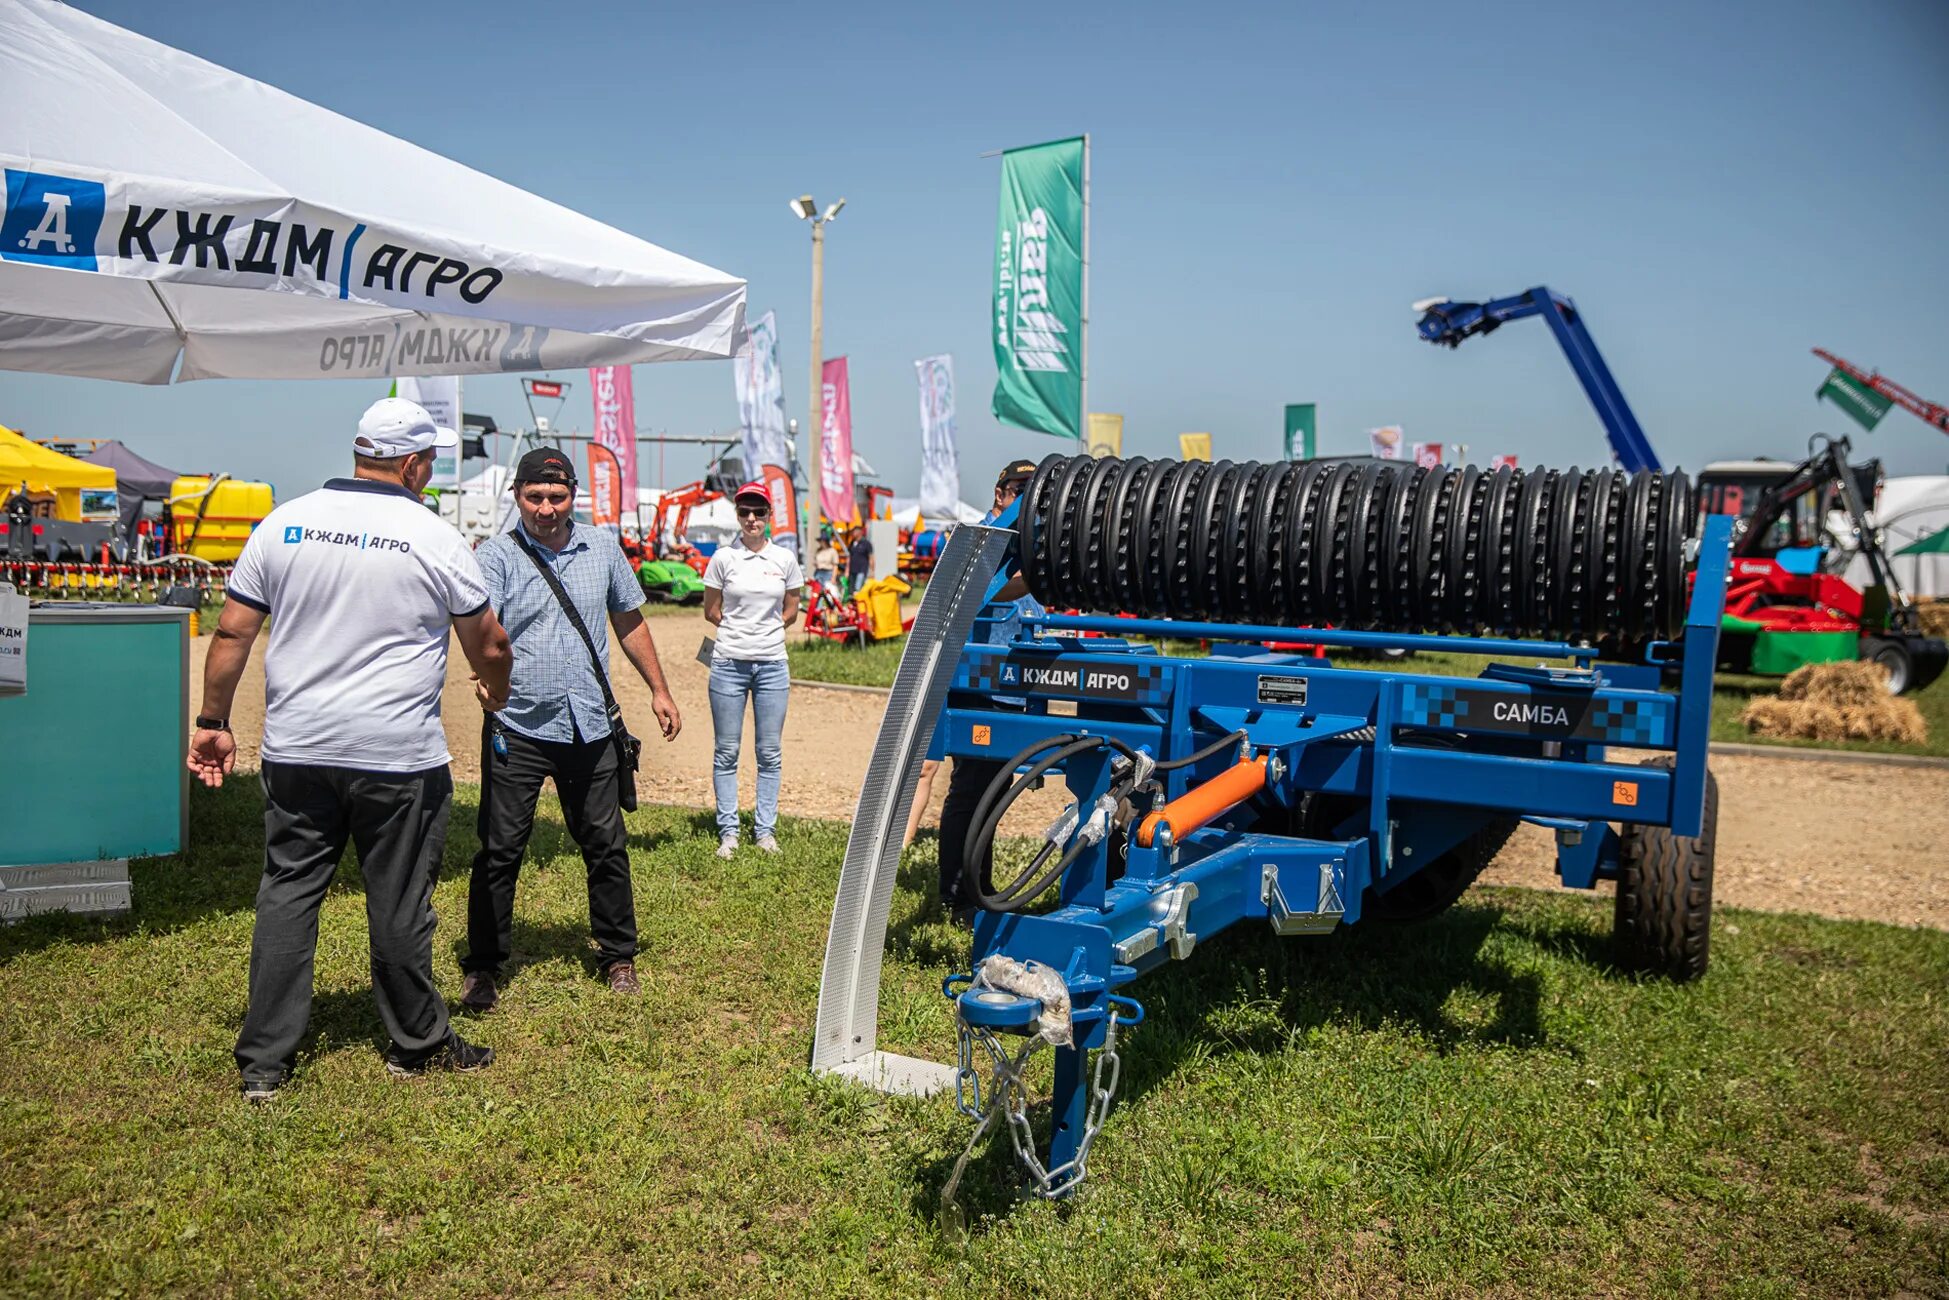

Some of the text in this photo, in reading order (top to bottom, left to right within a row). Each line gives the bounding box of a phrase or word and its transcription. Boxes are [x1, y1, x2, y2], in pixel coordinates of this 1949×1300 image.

[117, 204, 335, 282] КЖДМ
[362, 243, 504, 305] АГРО
[304, 528, 360, 547] КЖДМ
[369, 536, 411, 553] АГРО
[1023, 668, 1078, 687] КЖДМ
[1086, 672, 1130, 691] АГРО
[1493, 701, 1570, 726] САМБА
